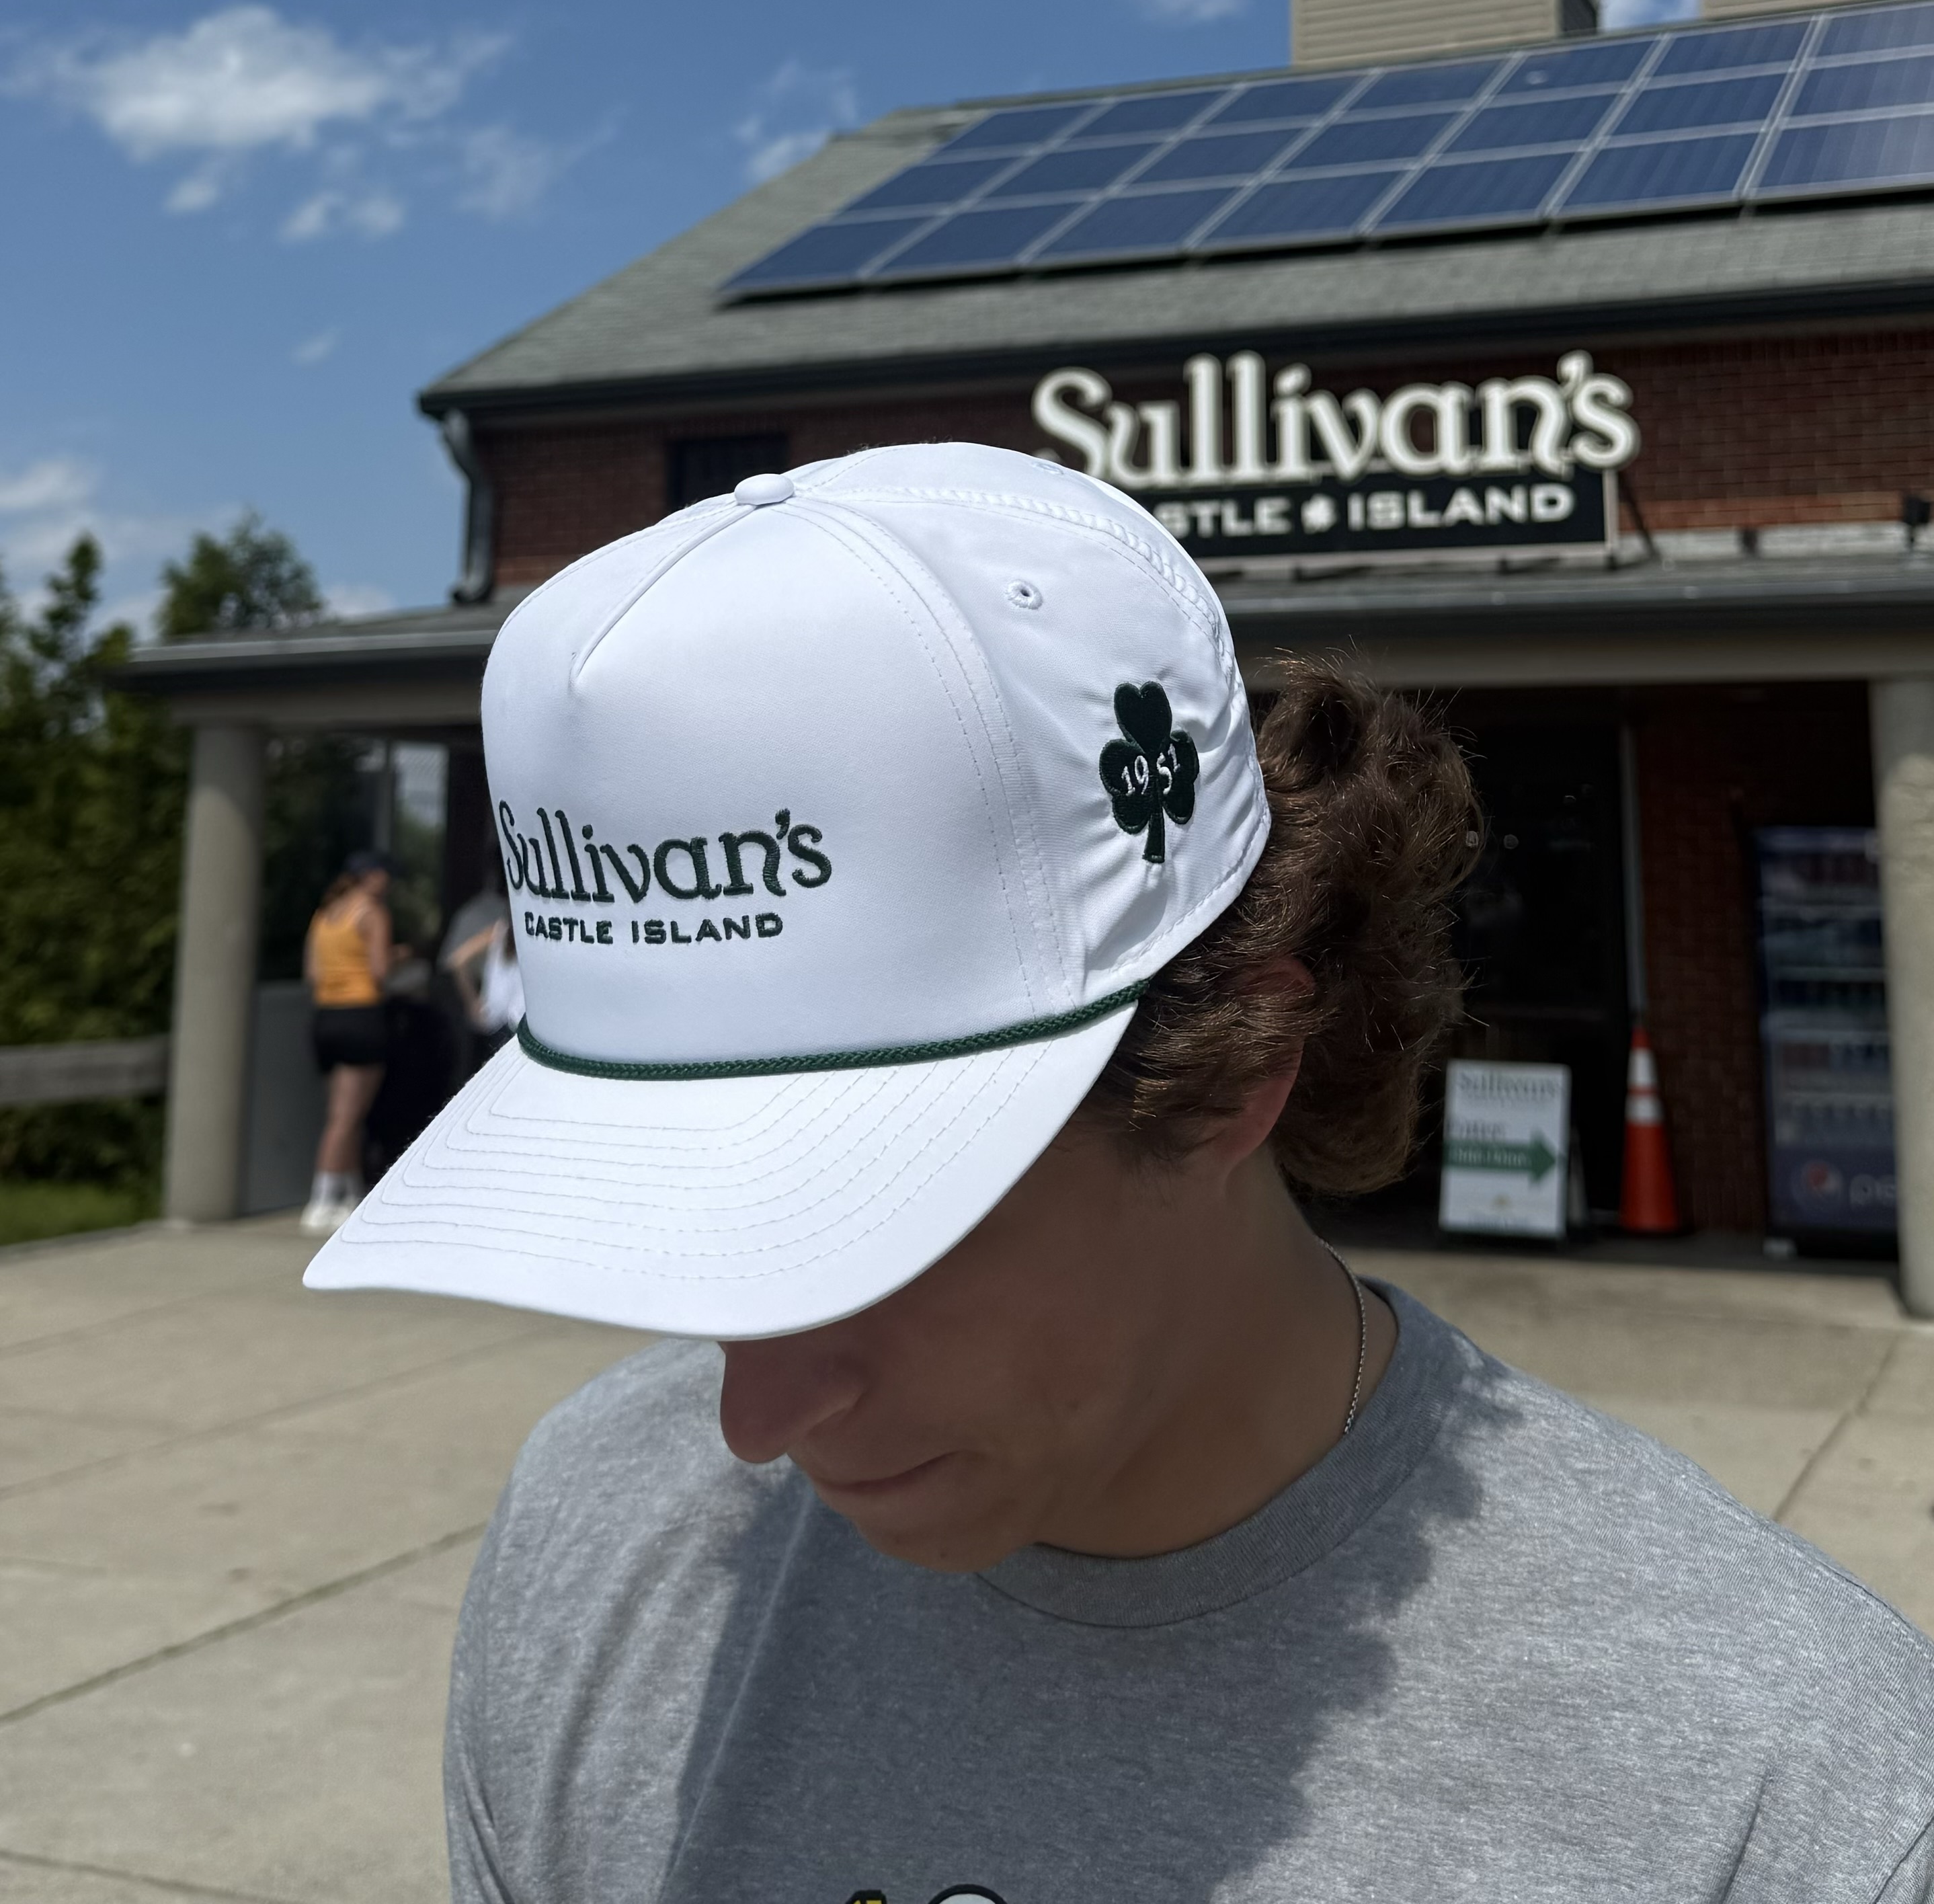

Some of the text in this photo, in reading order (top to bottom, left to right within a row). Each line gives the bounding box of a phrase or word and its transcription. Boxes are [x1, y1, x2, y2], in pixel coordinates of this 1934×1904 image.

[1031, 349, 1642, 489] Sullivan's
[1152, 483, 1575, 539] STLE ISLAND
[499, 799, 832, 904] Sullivan's
[524, 910, 784, 945] CASTLE ISLAND
